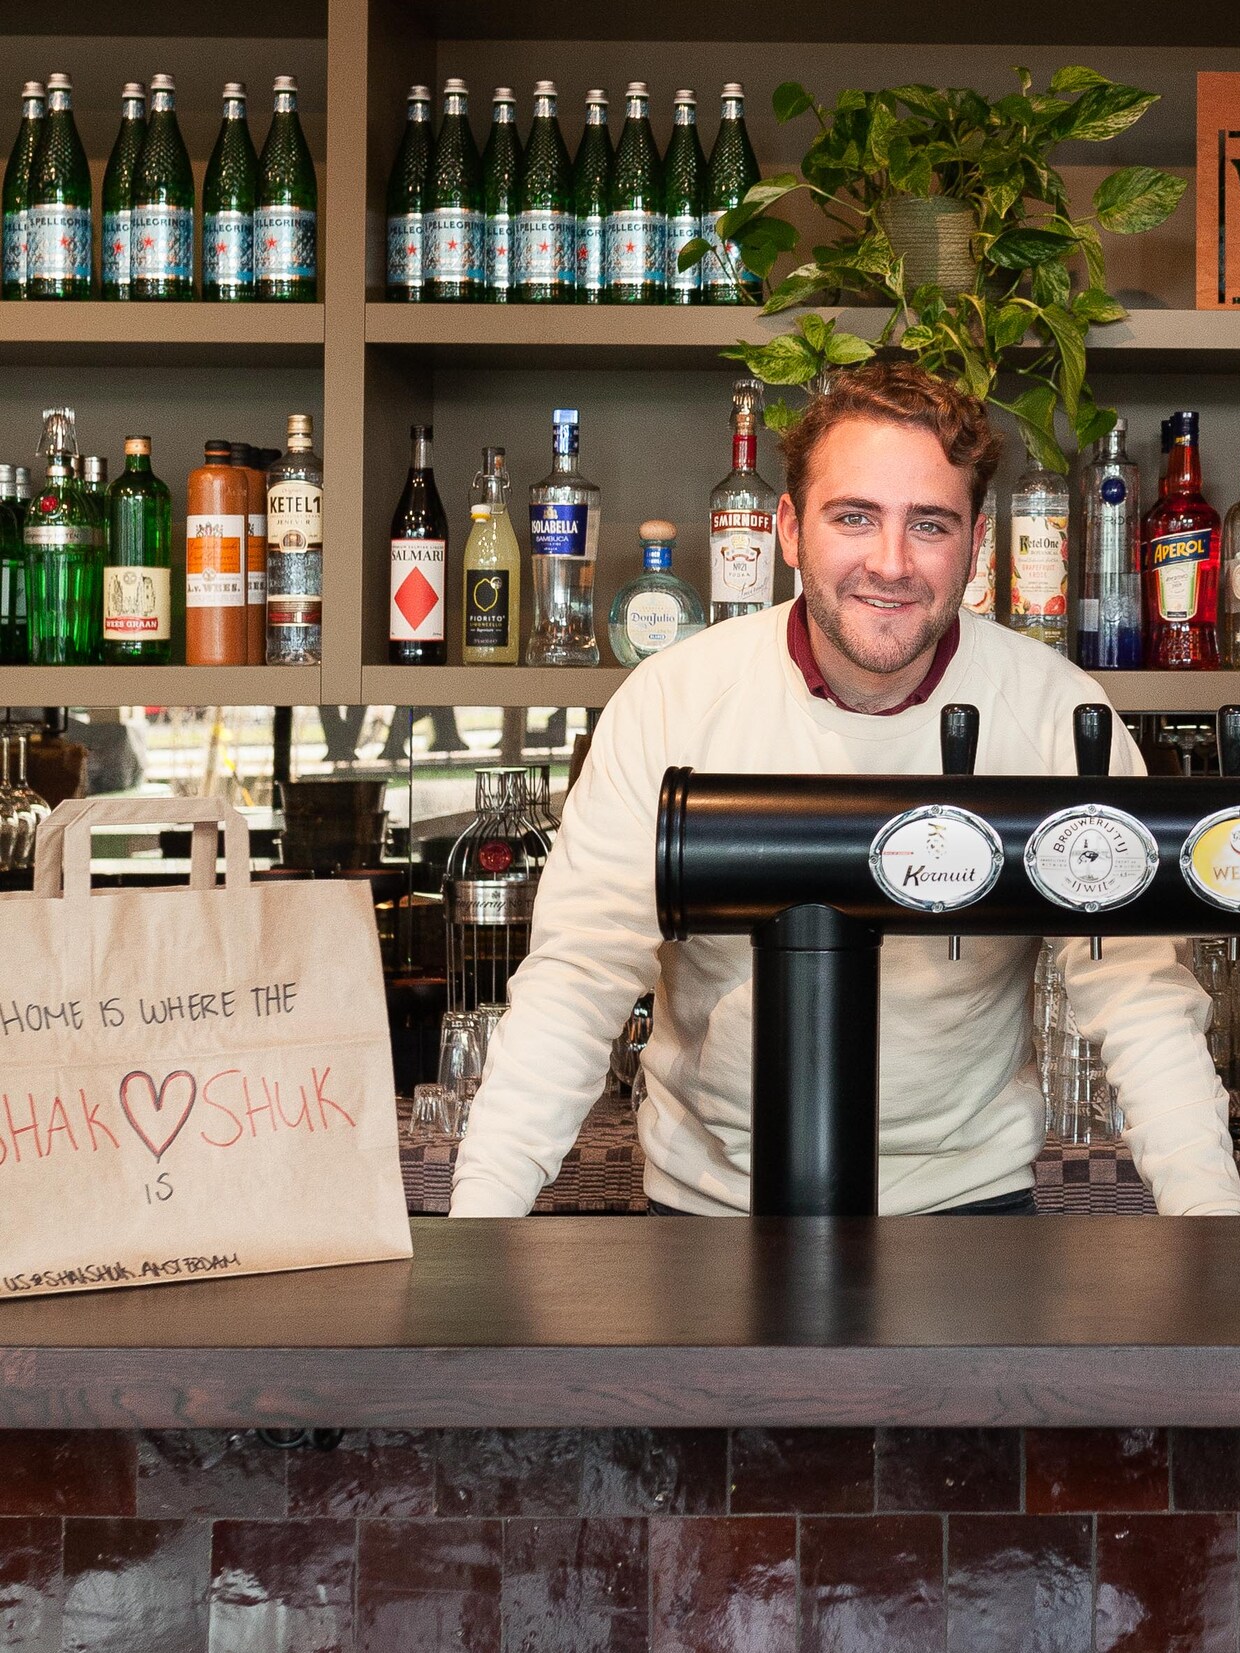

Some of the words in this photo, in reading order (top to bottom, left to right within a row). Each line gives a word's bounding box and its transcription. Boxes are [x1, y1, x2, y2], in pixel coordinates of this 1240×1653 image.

[531, 520, 578, 534] ISOLABELLA
[713, 513, 769, 529] SMIRNOFF
[1043, 538, 1059, 549] One
[1154, 539, 1205, 564] APEROL
[391, 550, 444, 561] SALMARI
[902, 865, 976, 887] Kornuit
[1, 999, 83, 1036] HOME
[100, 998, 126, 1028] IS
[140, 991, 236, 1025] WHERE
[250, 982, 299, 1018] THE
[200, 1066, 357, 1148] SHUK
[145, 1172, 174, 1205] IS
